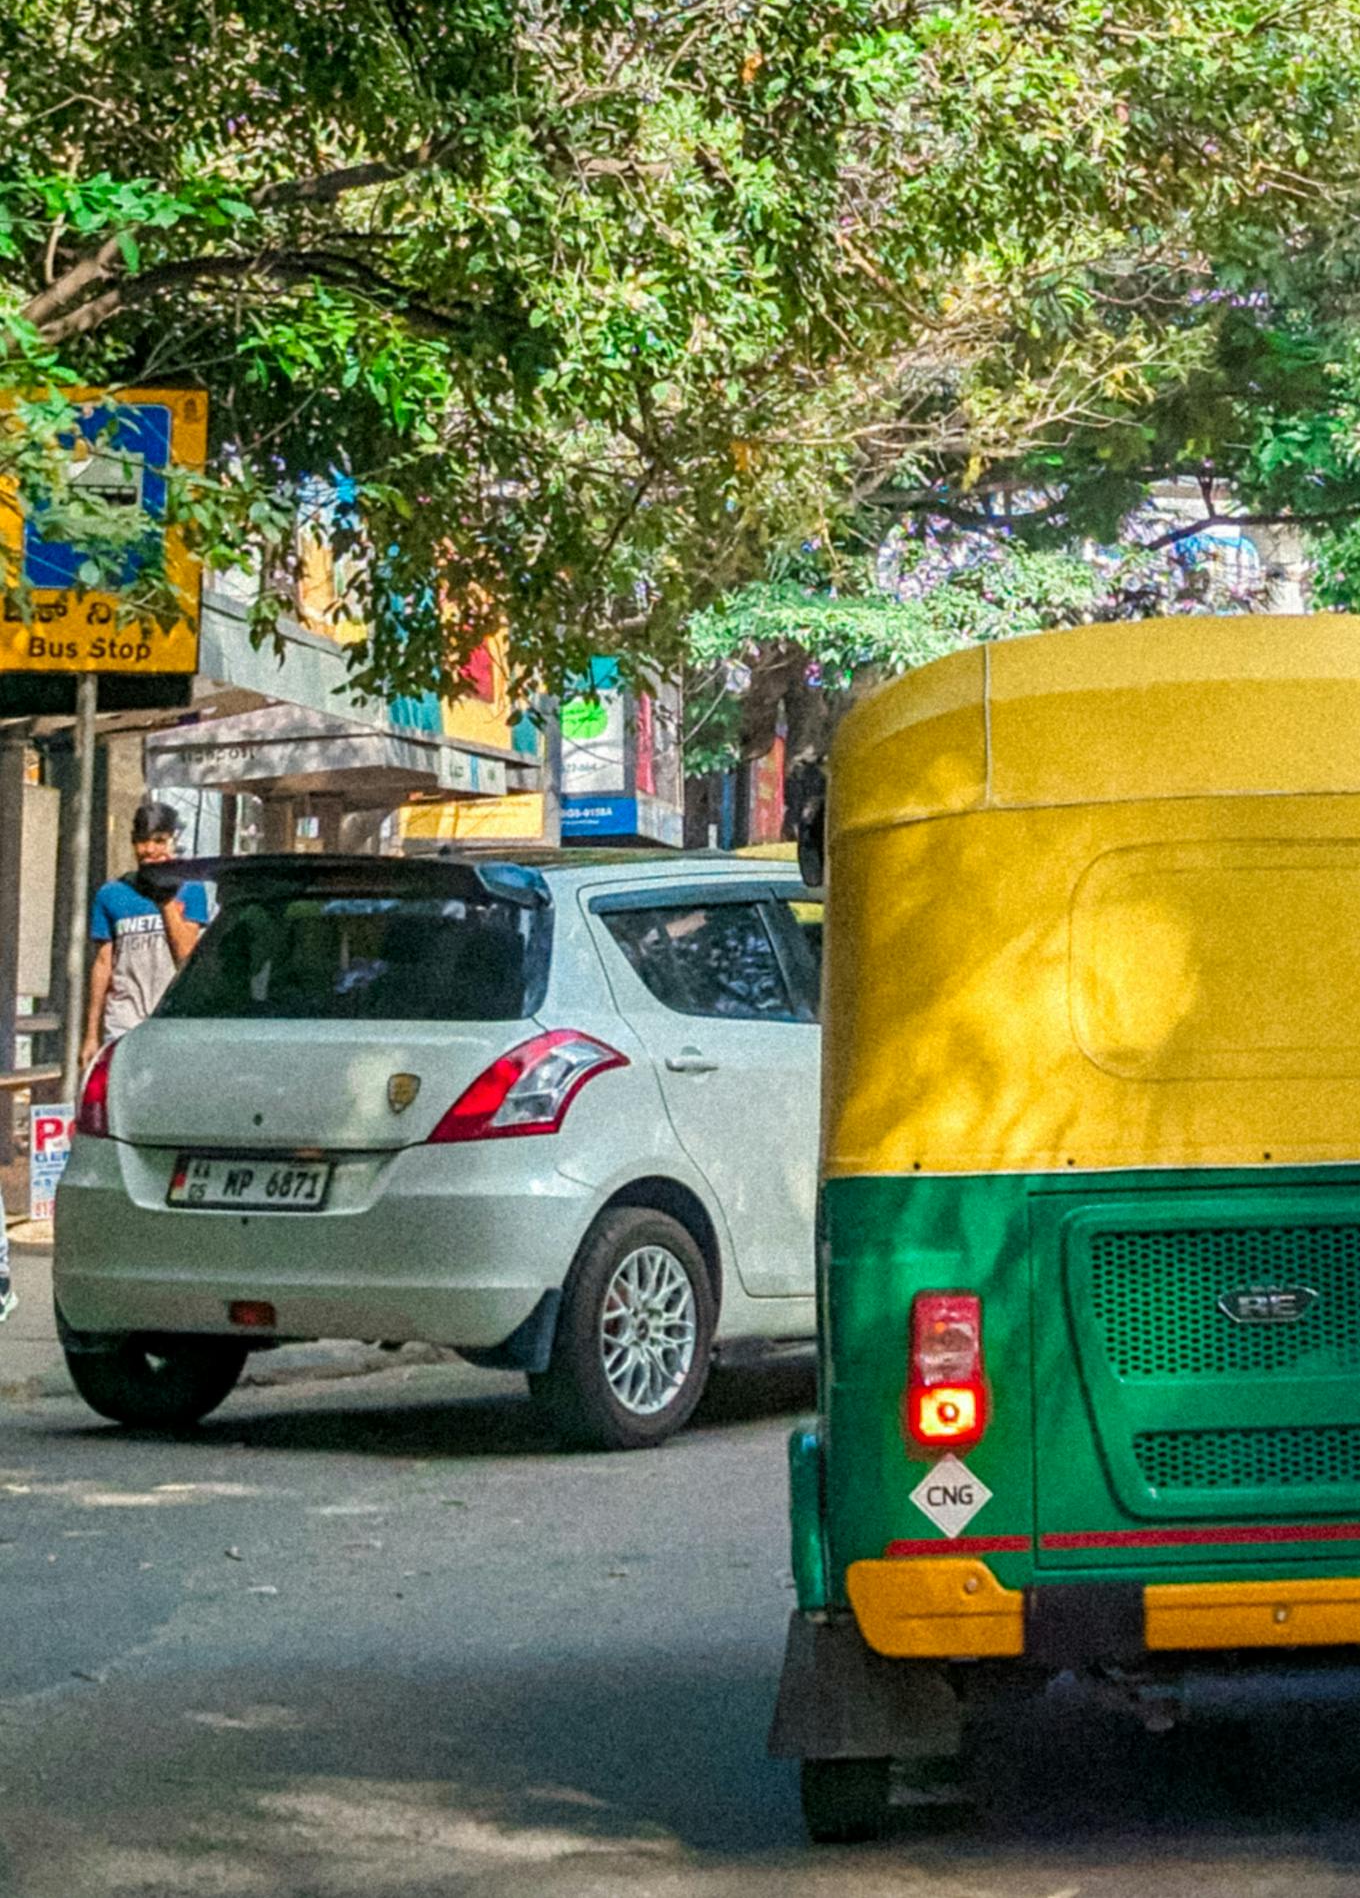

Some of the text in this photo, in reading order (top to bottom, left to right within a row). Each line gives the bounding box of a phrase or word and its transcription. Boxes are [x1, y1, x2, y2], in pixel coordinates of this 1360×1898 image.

[29, 636, 152, 662] Bus Stop
[265, 1171, 321, 1199] 6871
[927, 1484, 973, 1507] CNG
